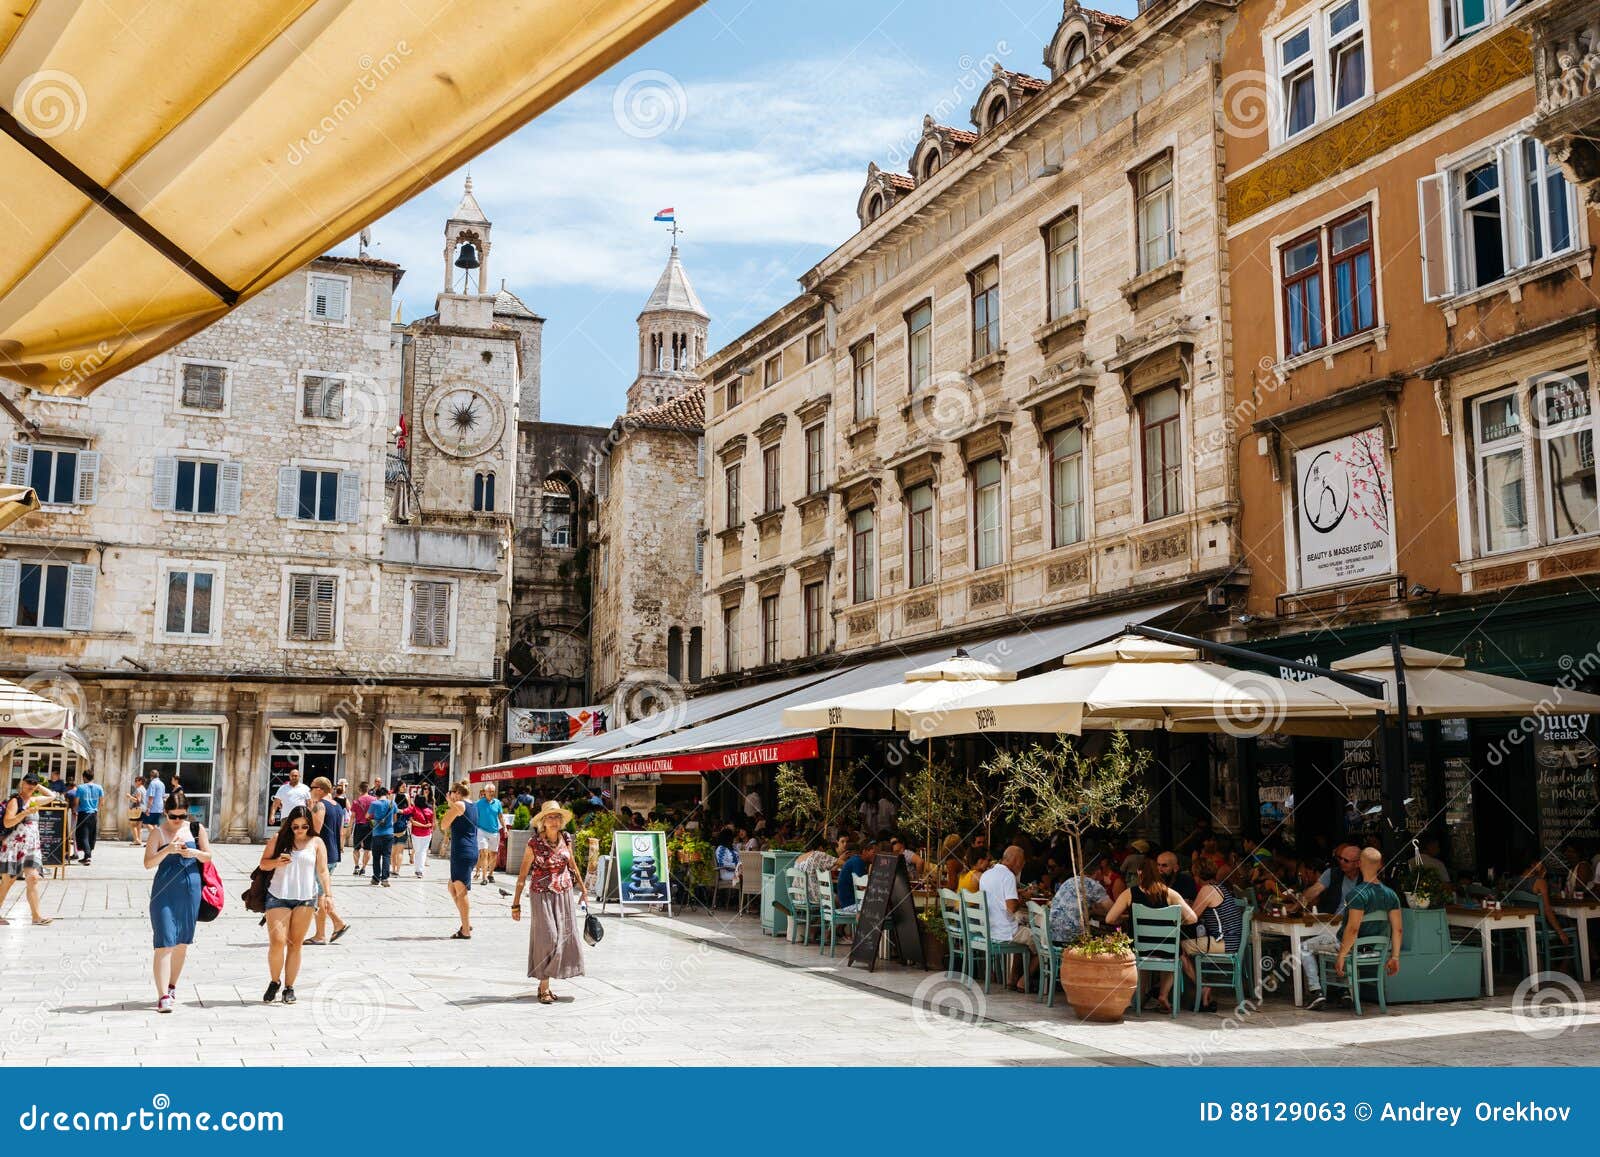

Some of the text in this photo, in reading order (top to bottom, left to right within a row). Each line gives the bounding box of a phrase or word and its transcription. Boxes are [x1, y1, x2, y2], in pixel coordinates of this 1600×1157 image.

[1553, 380, 1578, 396] REAL
[1553, 389, 1591, 408] ESTATE
[1554, 404, 1588, 422] AGENC
[1306, 539, 1384, 562] BEAUTY & MASSAGE STUDIO
[1538, 713, 1590, 735] Juicy
[1544, 728, 1579, 741] steaks
[651, 759, 673, 772] CENTRAL
[723, 747, 778, 767] CAFÉ DE LA VILLE
[1345, 766, 1382, 785] GOURME
[1551, 785, 1588, 804] pasta
